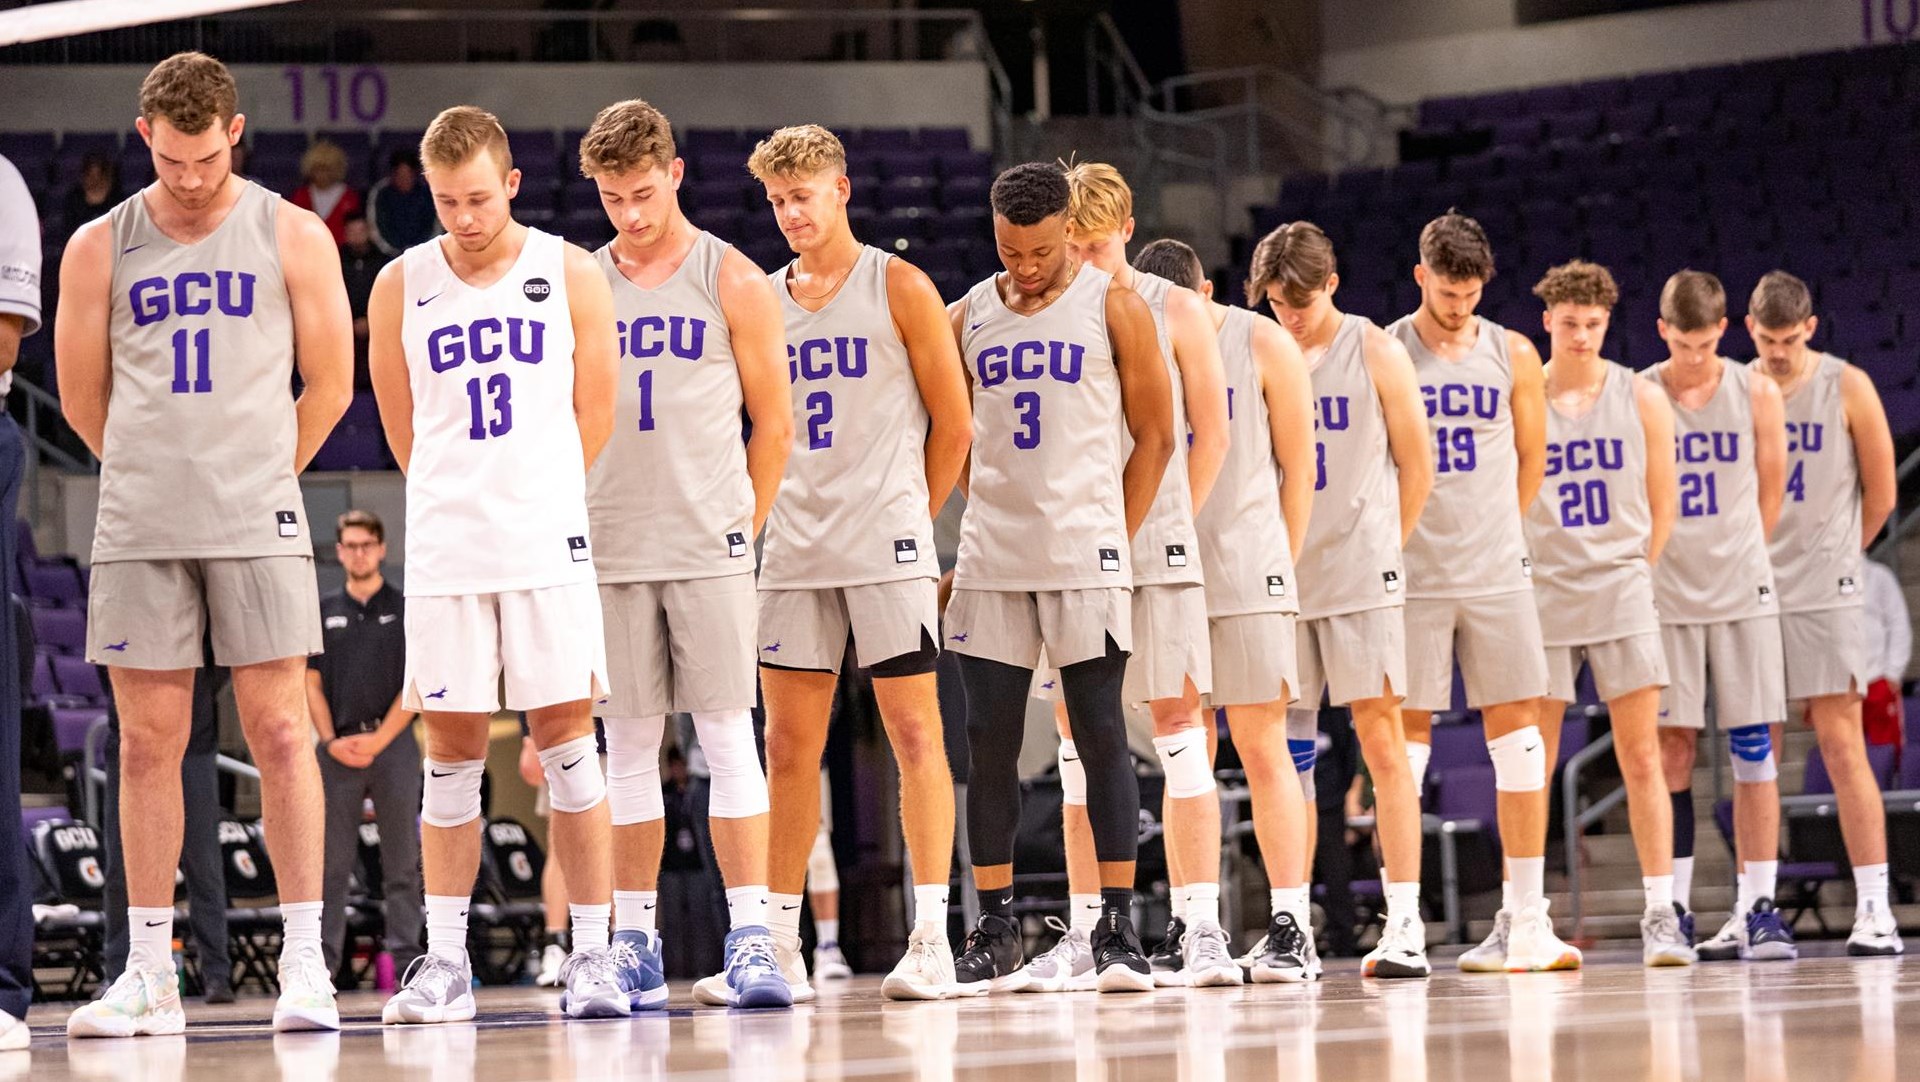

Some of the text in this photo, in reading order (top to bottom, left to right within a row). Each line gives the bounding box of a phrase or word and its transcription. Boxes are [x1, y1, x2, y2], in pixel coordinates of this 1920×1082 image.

[284, 65, 388, 123] 110
[129, 270, 256, 326] GCU
[524, 286, 550, 294] GOD
[171, 328, 212, 394] 11
[427, 317, 546, 373] GCU
[616, 316, 707, 361] CU
[787, 336, 868, 384] CU
[977, 340, 1085, 387] GCU
[466, 373, 513, 441] 13
[638, 370, 655, 431] 1
[806, 390, 833, 451] 2
[1014, 392, 1041, 449] 3
[1436, 426, 1477, 473] 19
[1675, 431, 1739, 463] CU
[1558, 479, 1610, 528] 20
[1679, 471, 1719, 517] 21
[54, 826, 99, 852] GCU
